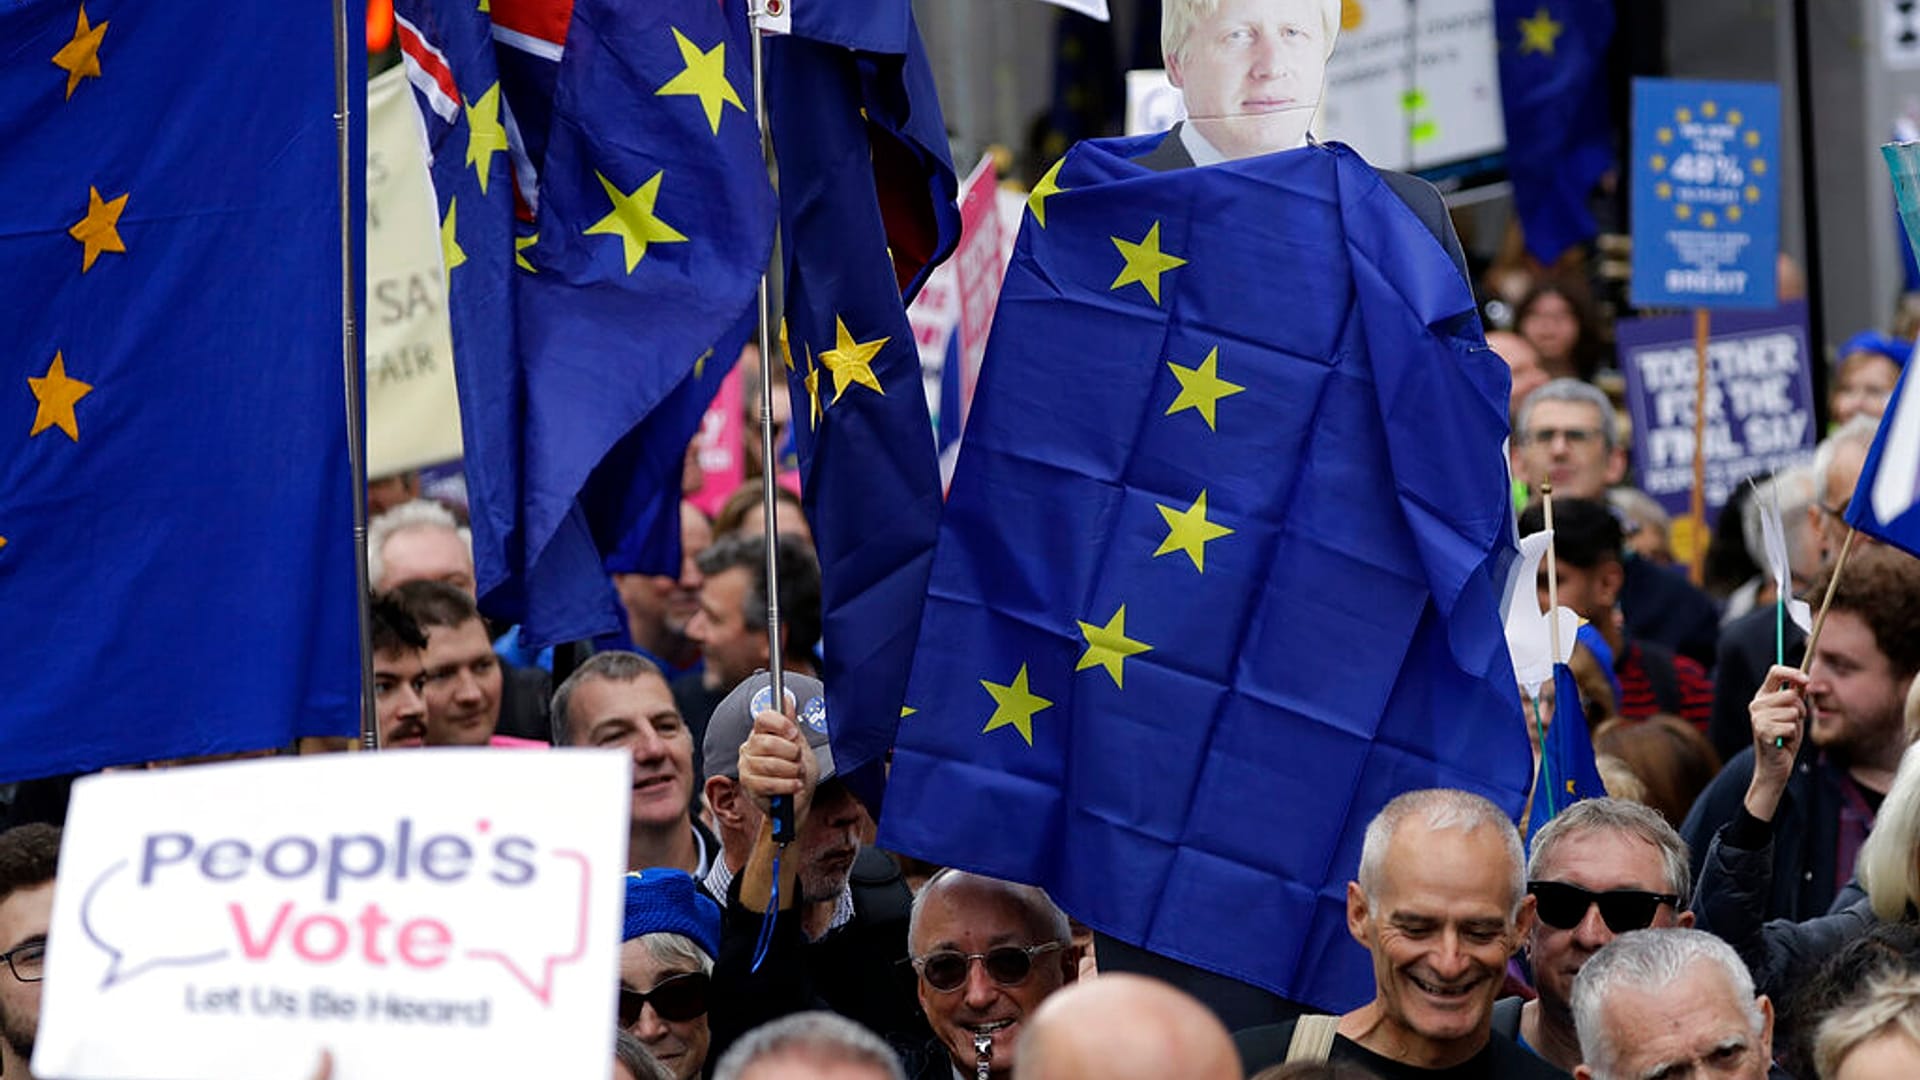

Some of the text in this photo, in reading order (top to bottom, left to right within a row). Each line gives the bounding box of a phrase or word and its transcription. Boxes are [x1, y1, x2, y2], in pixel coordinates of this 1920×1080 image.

[1665, 270, 1748, 293] BREXIT
[1744, 410, 1807, 455] SAY
[138, 818, 538, 903] People's
[227, 901, 454, 969] Vote
[185, 985, 493, 1026] Let Us Be Heard
